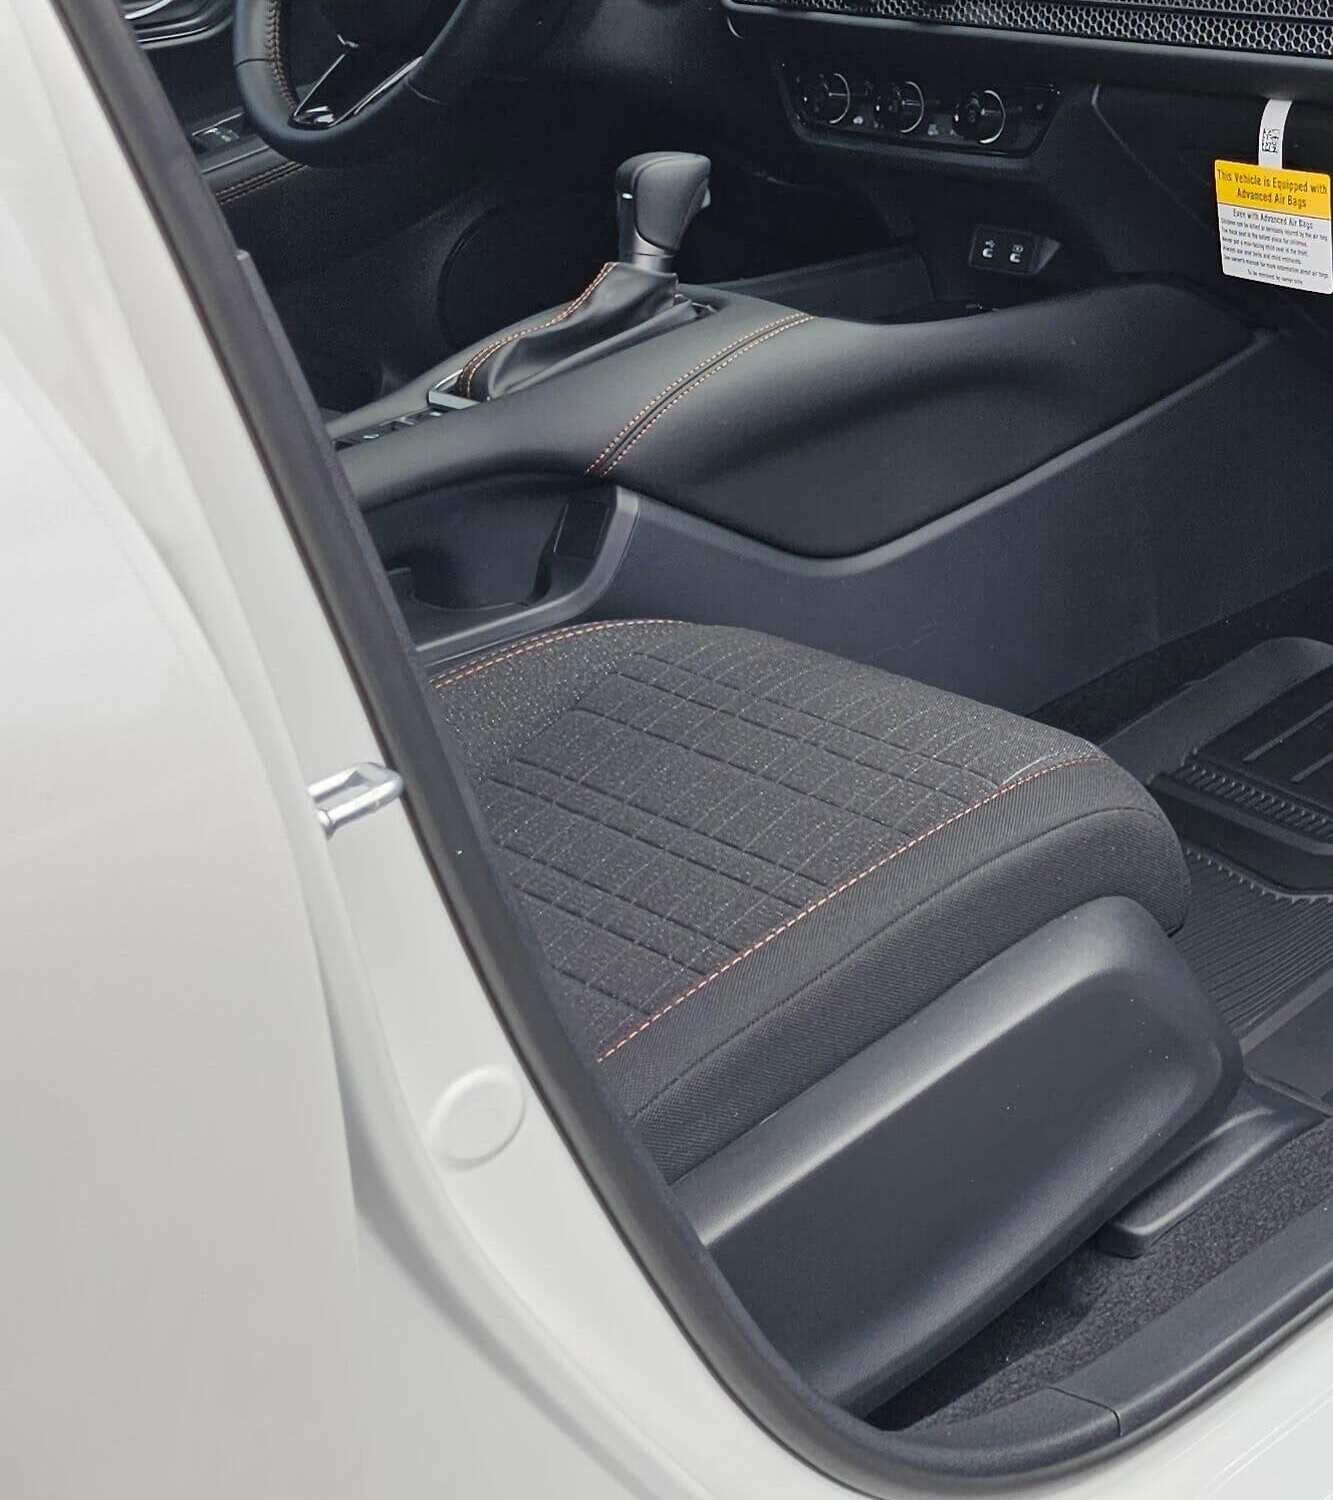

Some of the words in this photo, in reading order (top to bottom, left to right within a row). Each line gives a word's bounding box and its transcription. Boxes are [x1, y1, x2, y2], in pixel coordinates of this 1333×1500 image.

[1217, 170, 1232, 180] This
[1233, 172, 1261, 185] Vehicle
[1263, 177, 1270, 186] is
[1271, 177, 1308, 193] Equipped
[1309, 184, 1327, 194] with
[1236, 188, 1272, 202] Advanced
[1273, 193, 1285, 203] Air
[1287, 195, 1306, 210] Bags
